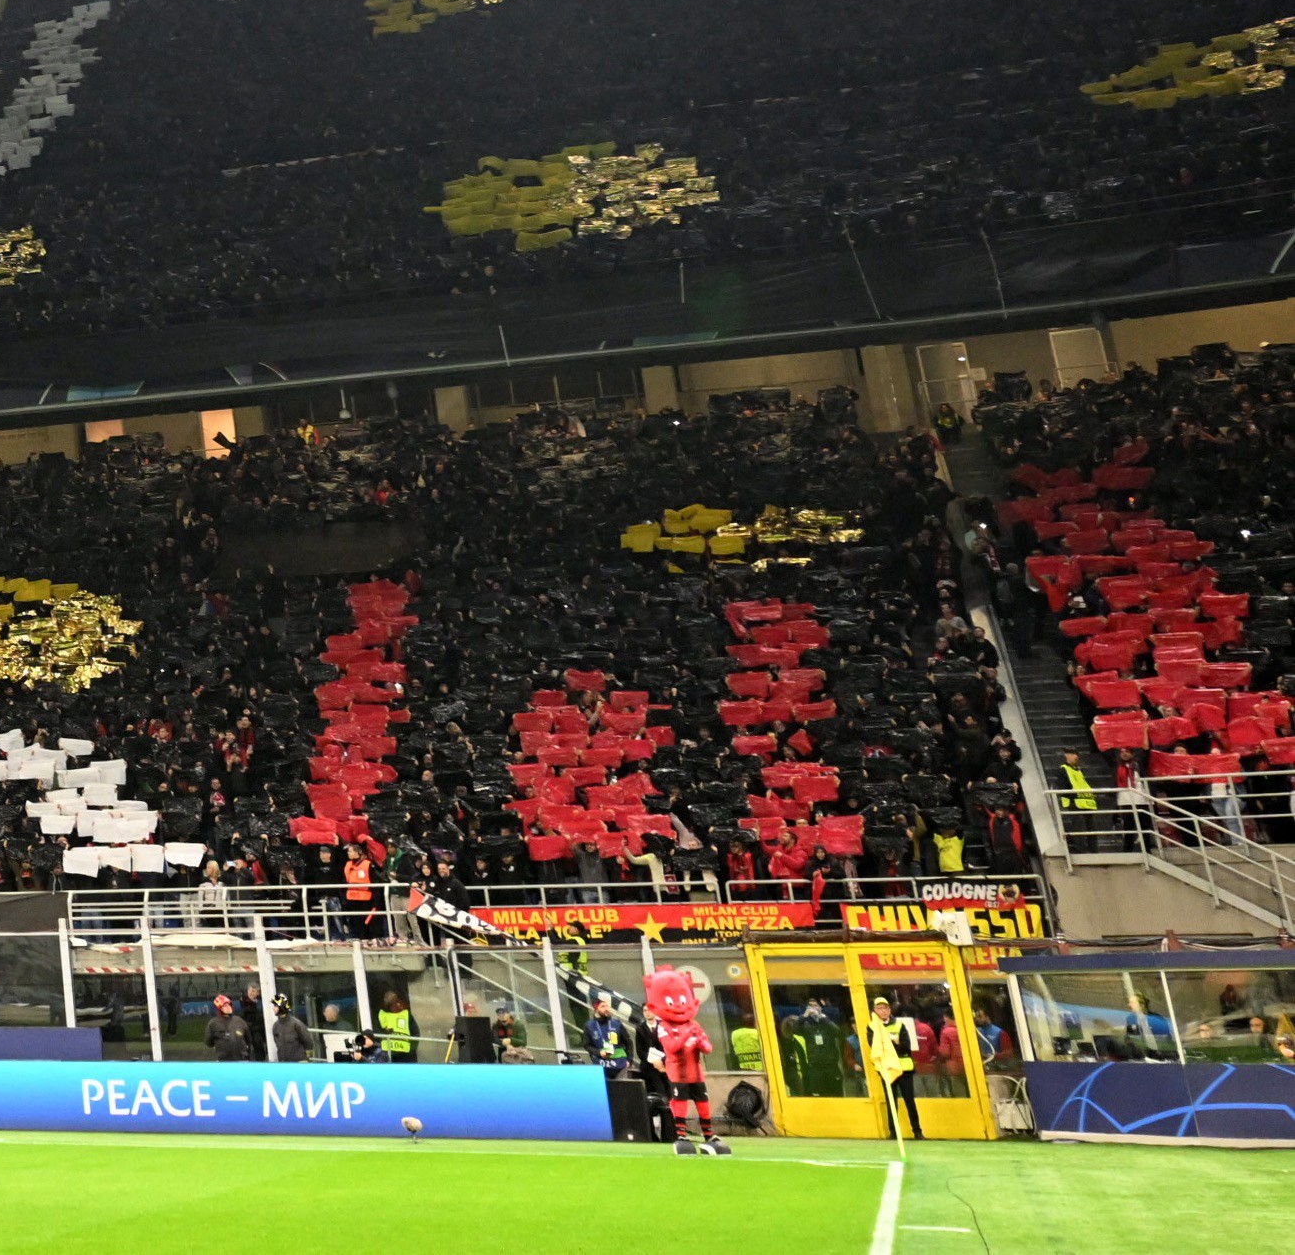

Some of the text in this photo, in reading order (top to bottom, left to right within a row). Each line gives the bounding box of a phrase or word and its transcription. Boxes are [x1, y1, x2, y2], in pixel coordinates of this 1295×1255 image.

[922, 882, 997, 901] COLOGNE
[493, 908, 620, 924] MILAN CLUB
[693, 906, 779, 916] MILAN CLUB
[681, 916, 794, 931] PIANEZZA
[846, 904, 1044, 938] CHIVSSO
[82, 1079, 216, 1117] PEACE
[262, 1081, 366, 1119] МИР
